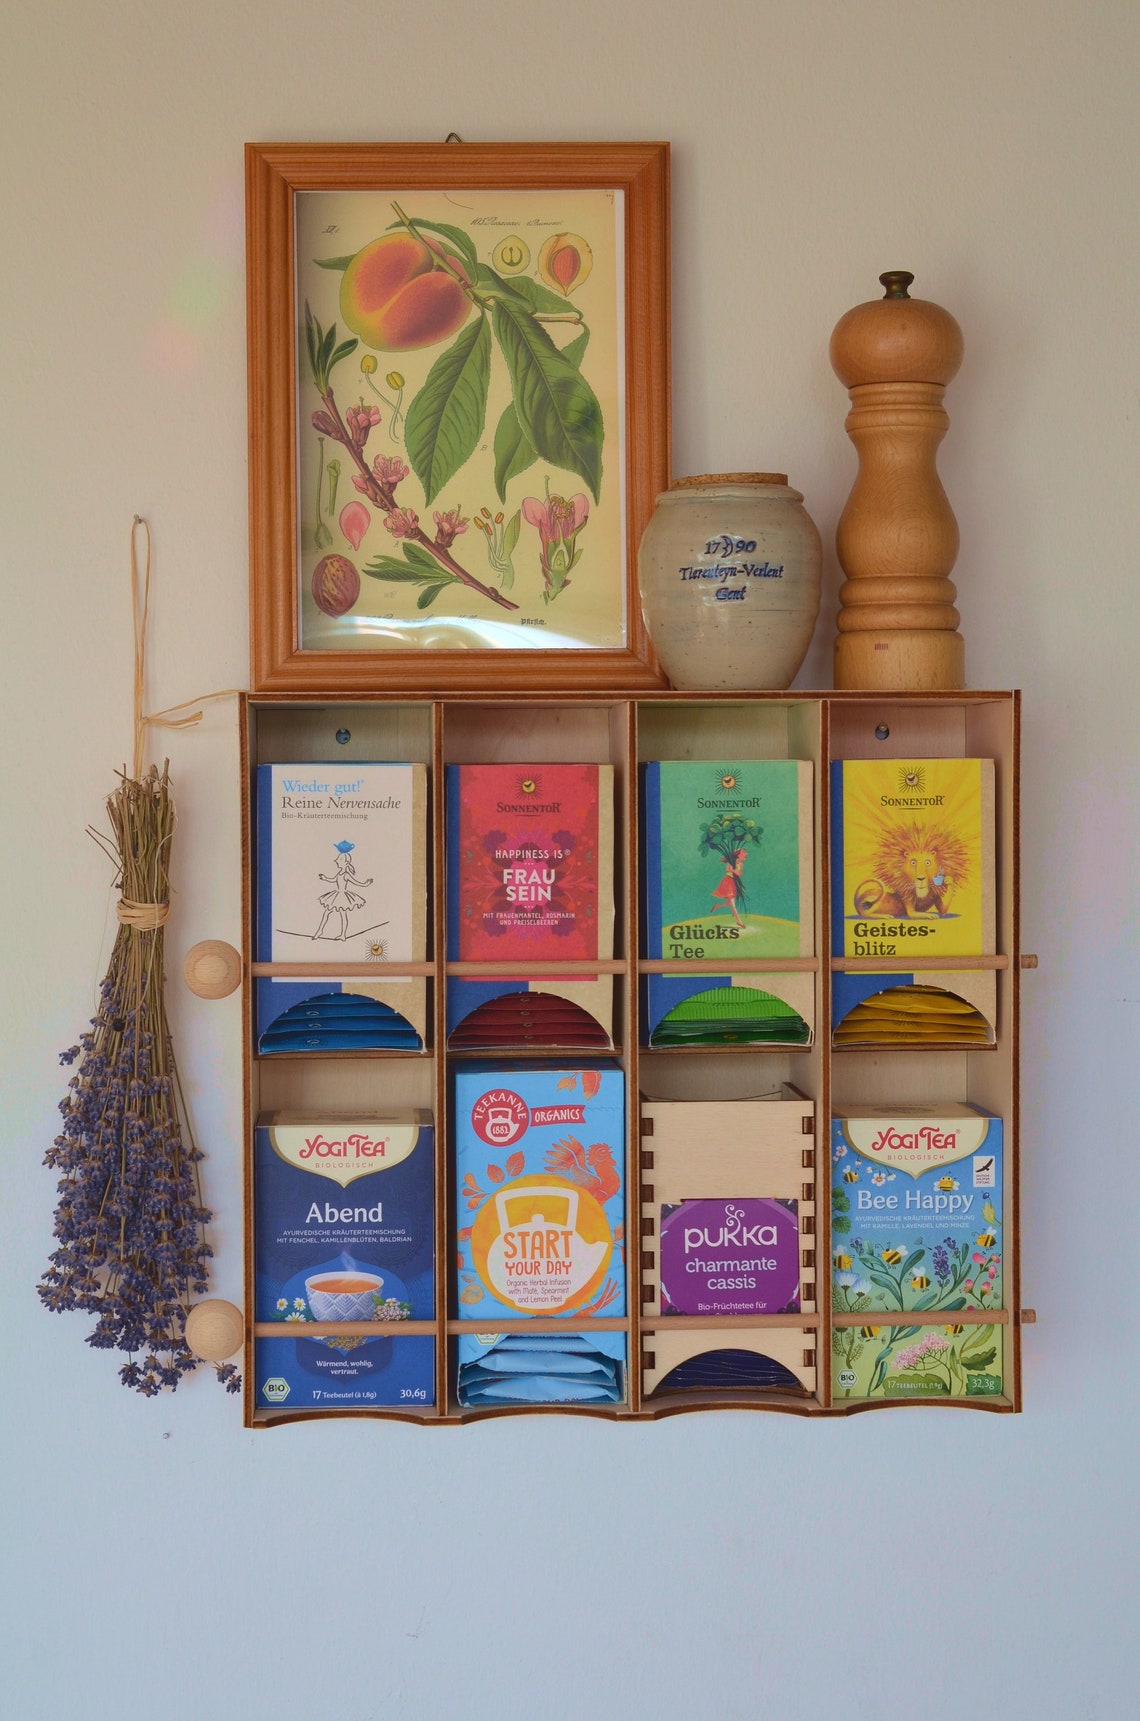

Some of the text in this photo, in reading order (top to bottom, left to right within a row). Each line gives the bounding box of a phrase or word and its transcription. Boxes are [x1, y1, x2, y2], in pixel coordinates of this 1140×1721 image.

[704, 540, 757, 554] 17 90
[282, 779, 330, 793] Wieder
[281, 796, 401, 810] Reine Nervensache
[281, 811, 369, 821] Bio-Kräuterteemischung
[495, 850, 549, 859] HAPPINESS
[503, 869, 556, 885] FRAU
[506, 886, 552, 901] SEIN
[669, 924, 740, 940] Glücks
[853, 922, 936, 937] Geistes-
[669, 944, 705, 959] Tee
[853, 941, 896, 956] blitz
[474, 1092, 527, 1121] TEEKANNE
[535, 1109, 580, 1122] ORGANICS
[857, 1190, 974, 1214] Bee Happy
[306, 1202, 383, 1223] Abend
[503, 1230, 573, 1260] START
[685, 1225, 777, 1253] pukka
[505, 1261, 572, 1276] YOUR DAY
[685, 1257, 777, 1272] charmante
[507, 1279, 528, 1288] Organic
[707, 1275, 756, 1290] cassis
[541, 1287, 569, 1295] Spearmint
[698, 1303, 754, 1311] Bio-Früchtetee
[350, 1360, 373, 1368] wohlig,
[888, 1380, 895, 1388] 17
[312, 1390, 321, 1399] 17
[400, 1388, 426, 1399] 30,6g
